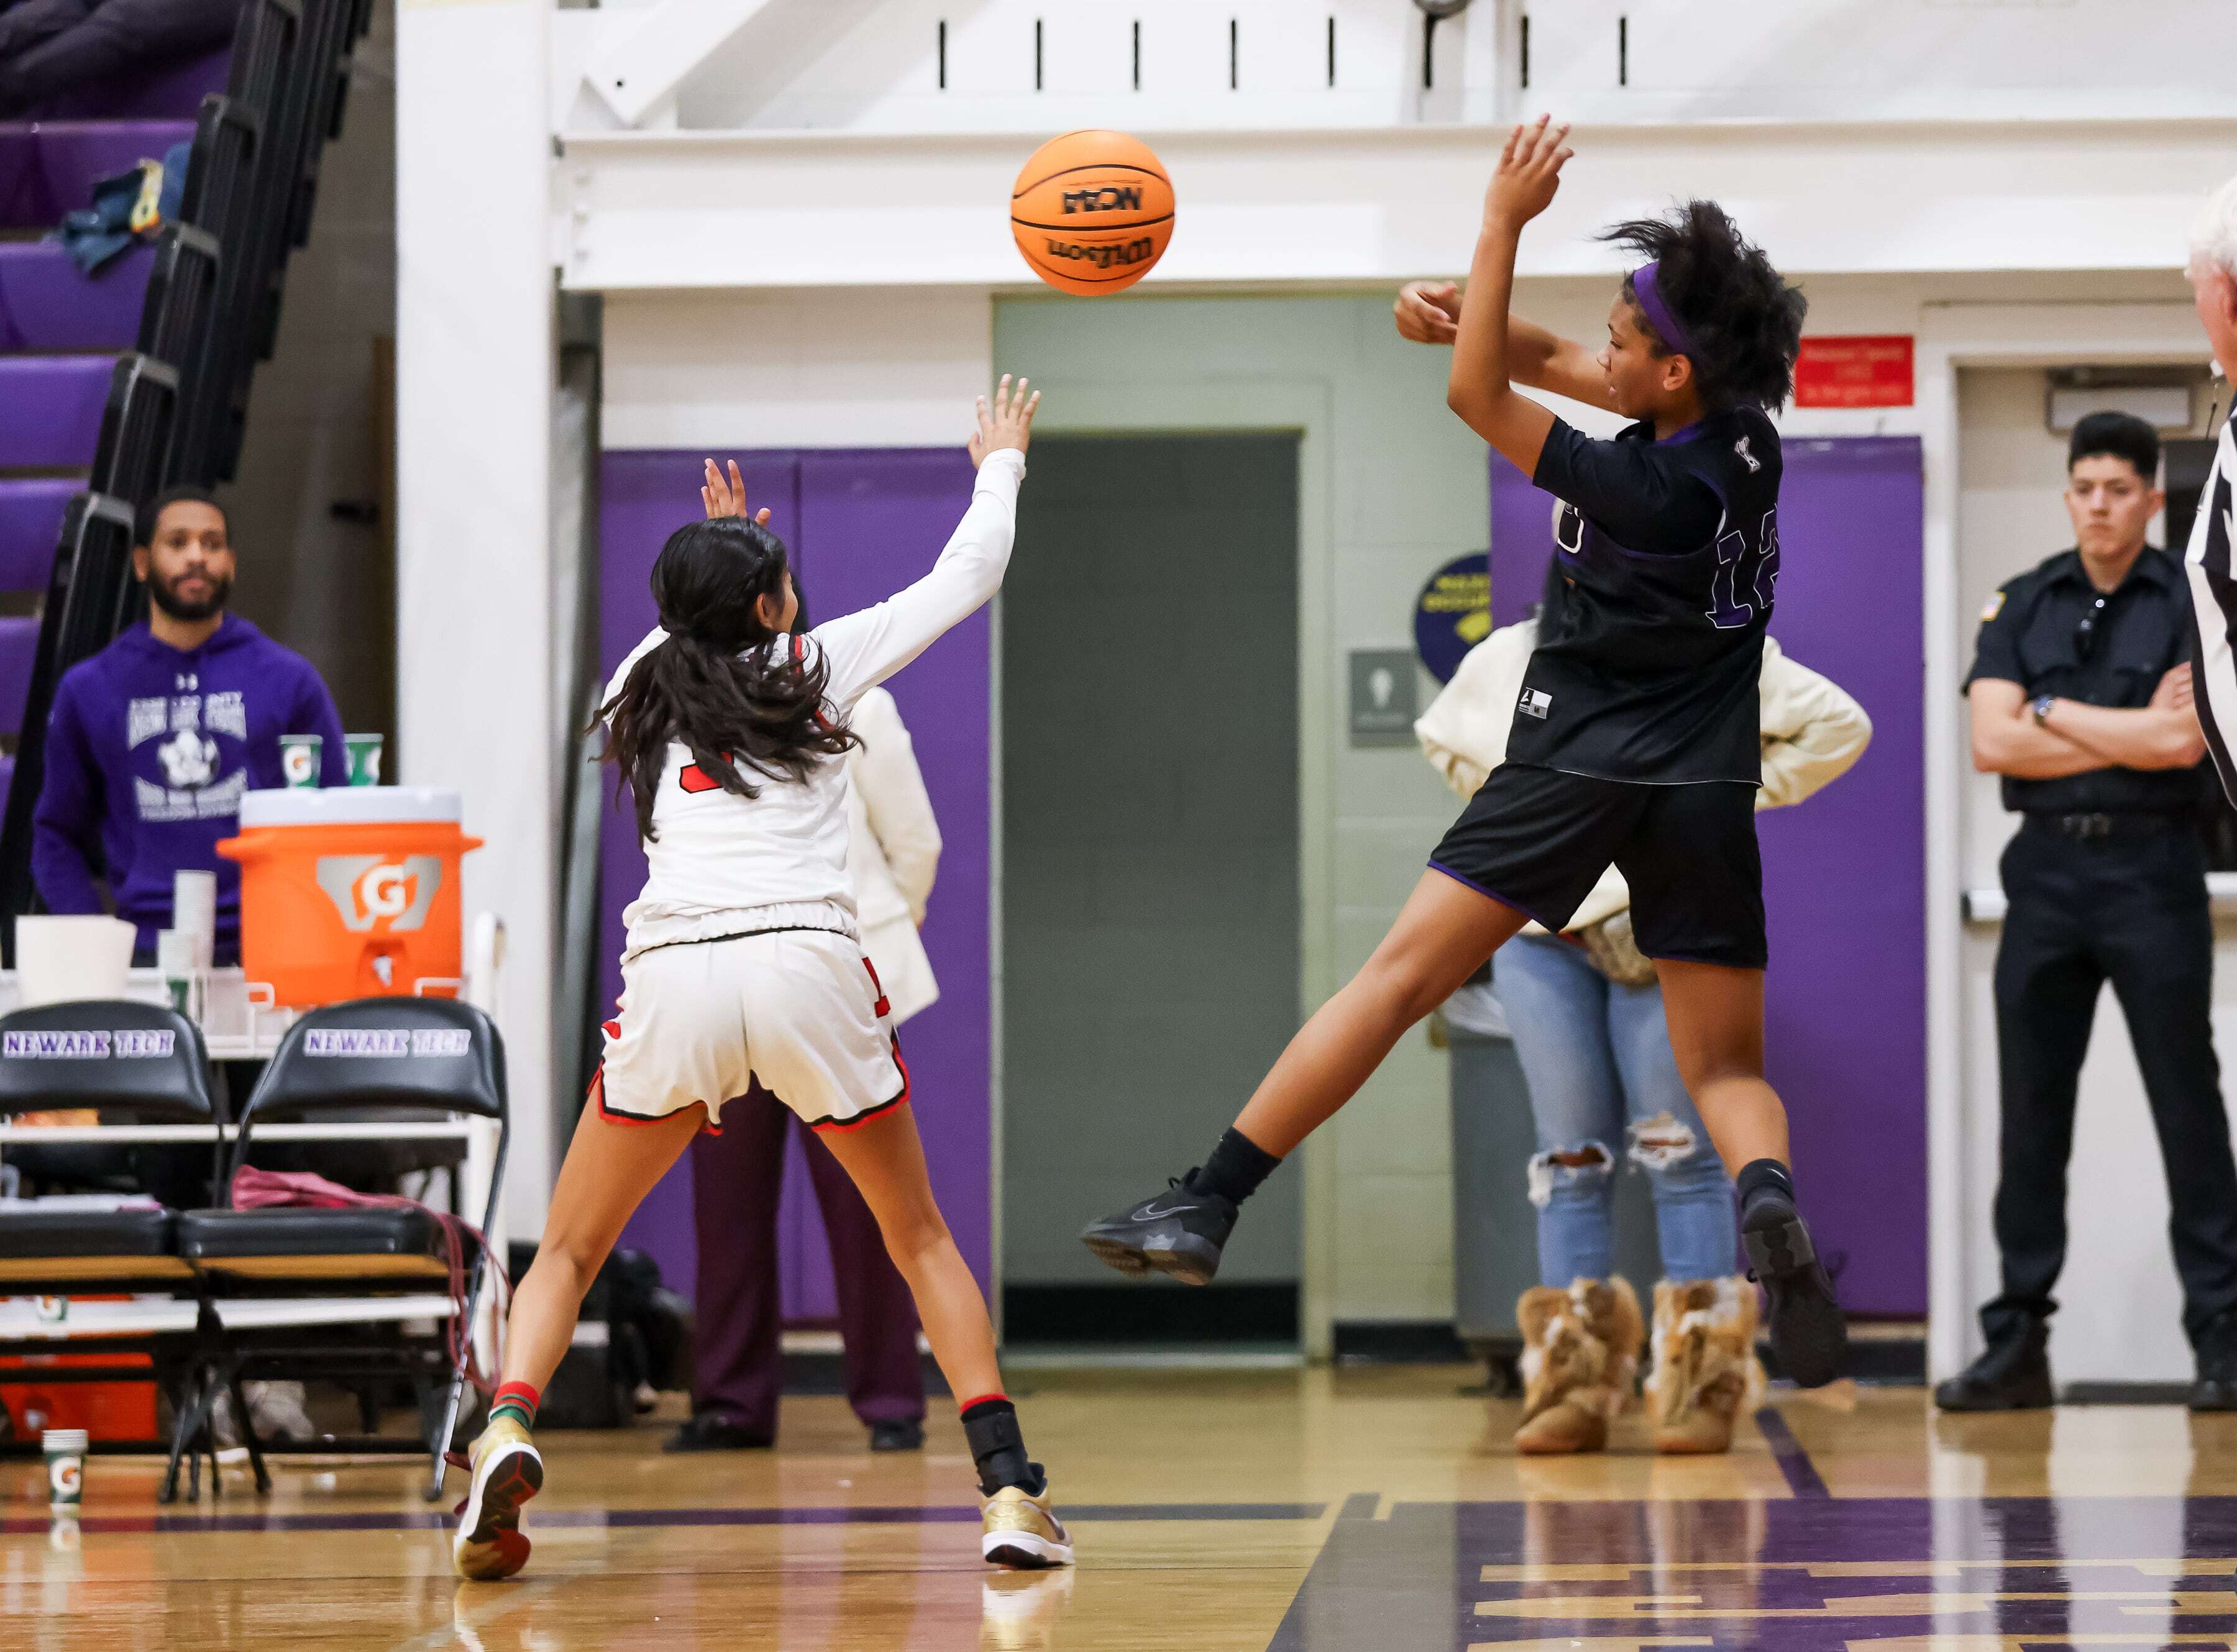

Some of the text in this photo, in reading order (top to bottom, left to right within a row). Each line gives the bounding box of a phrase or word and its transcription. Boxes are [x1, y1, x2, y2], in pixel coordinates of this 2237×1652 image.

[1061, 186, 1143, 214] NCAA
[362, 864, 406, 916] G
[2, 1029, 175, 1059] NEWARK TECH
[304, 1029, 410, 1057] NEWARK
[50, 1456, 81, 1495] G
